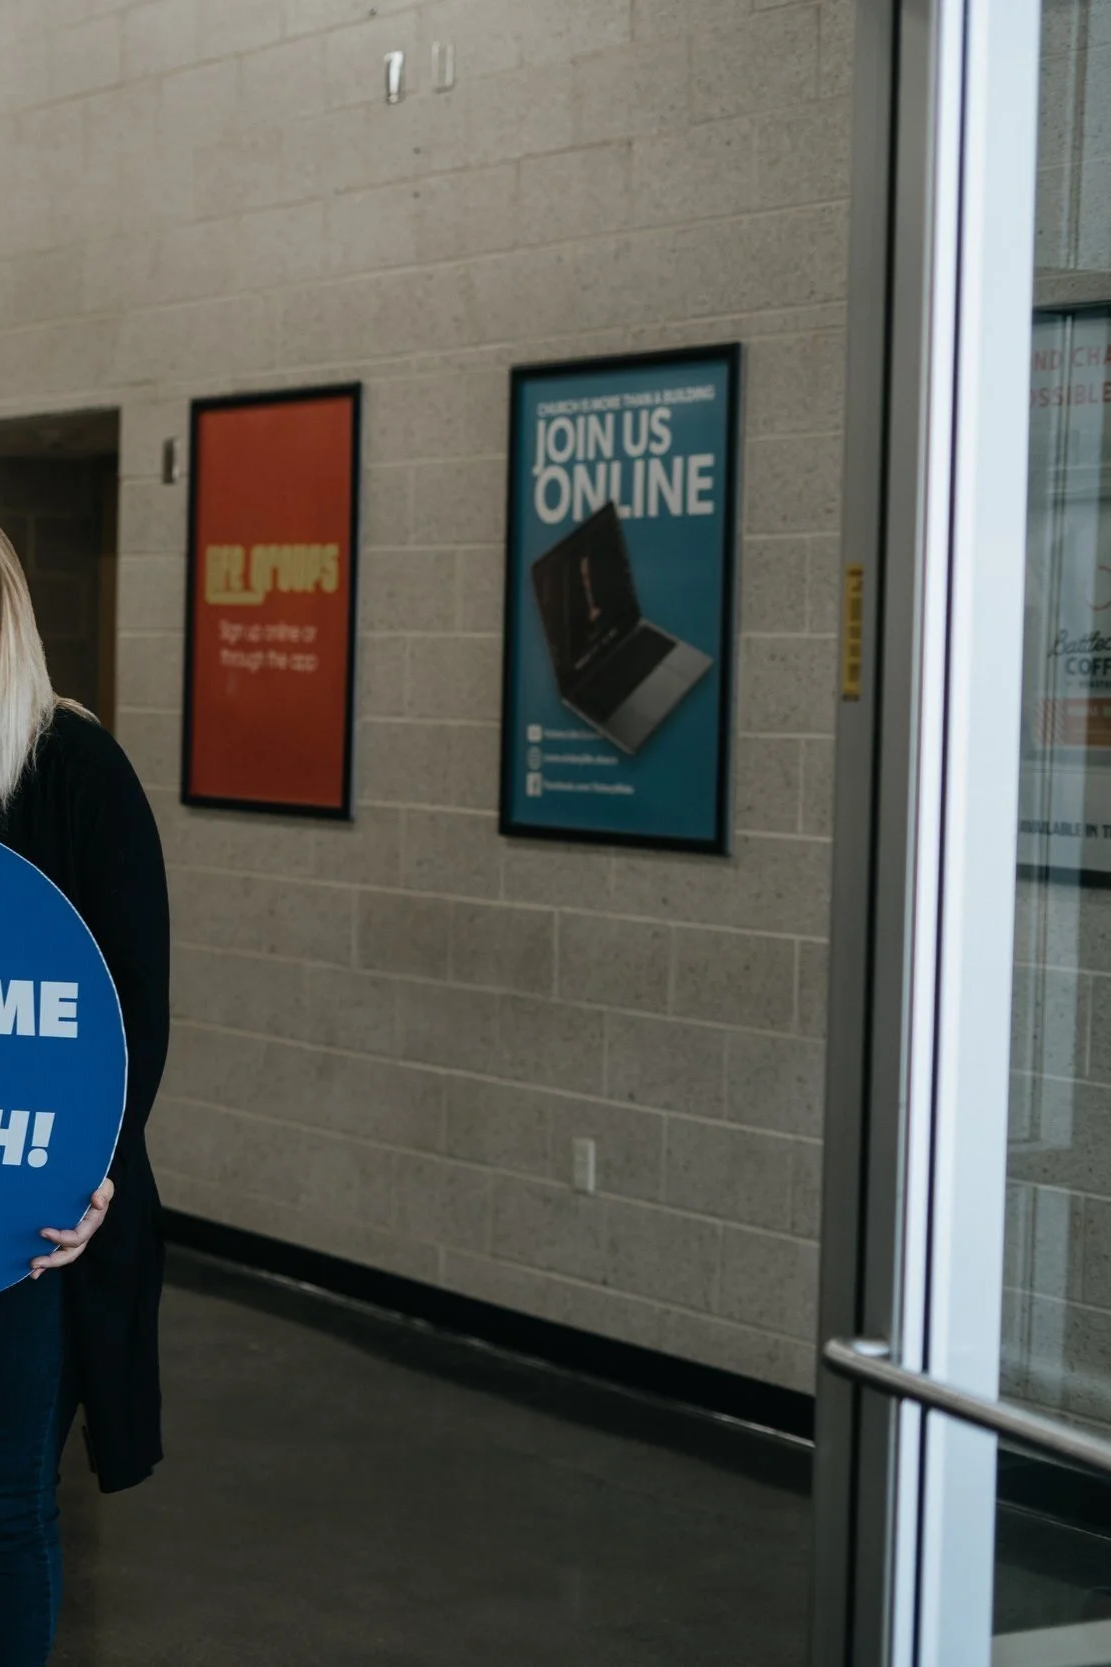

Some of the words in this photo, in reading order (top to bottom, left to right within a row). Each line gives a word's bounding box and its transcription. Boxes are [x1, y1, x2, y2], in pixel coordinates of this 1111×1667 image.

[533, 411, 615, 475] JOIN
[623, 406, 673, 457] US
[535, 453, 715, 525] ONLINE
